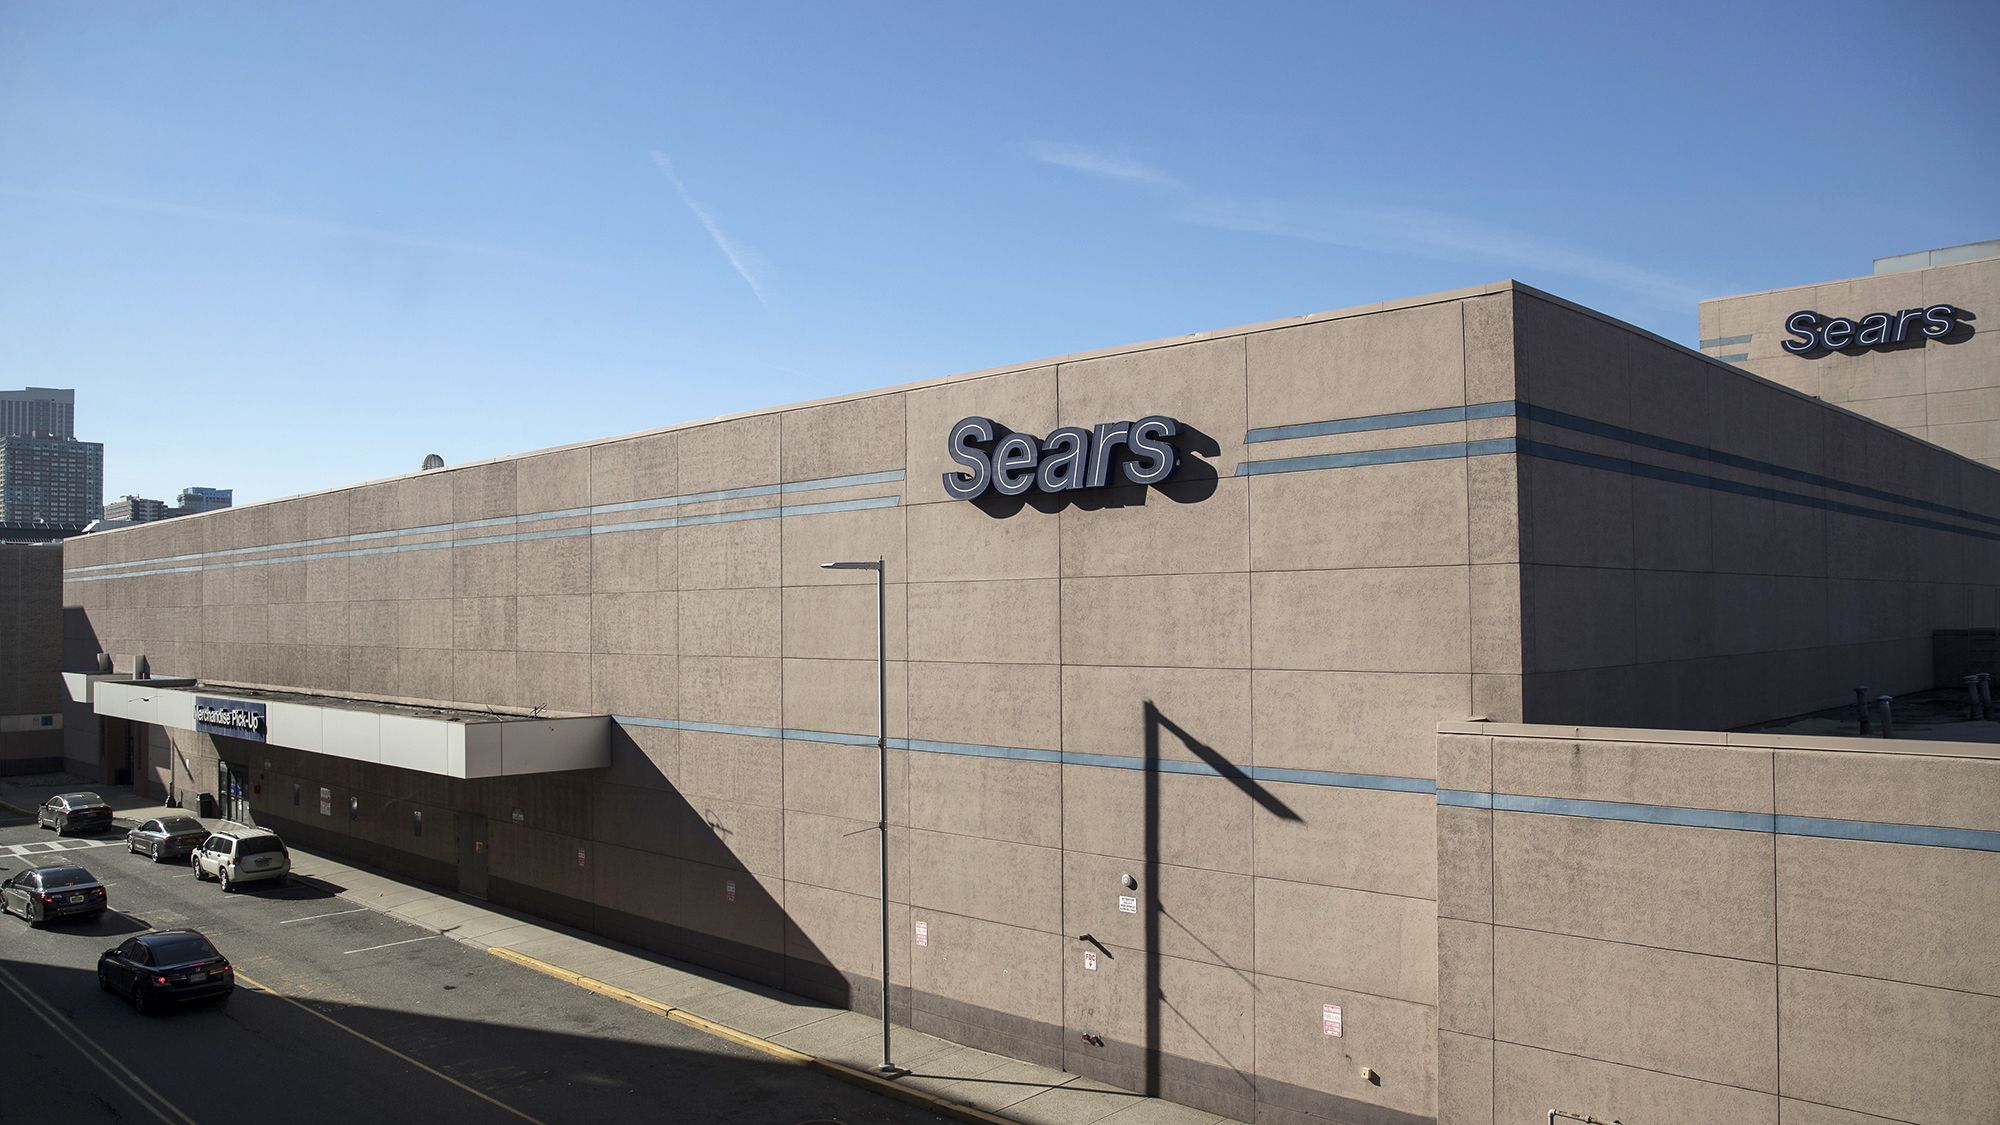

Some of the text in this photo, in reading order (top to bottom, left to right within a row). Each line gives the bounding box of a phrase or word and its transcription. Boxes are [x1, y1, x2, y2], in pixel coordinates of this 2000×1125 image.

[1780, 304, 1954, 353] Sears
[942, 415, 1177, 500] Sears
[194, 705, 259, 733] Merchandise Pick-Up
